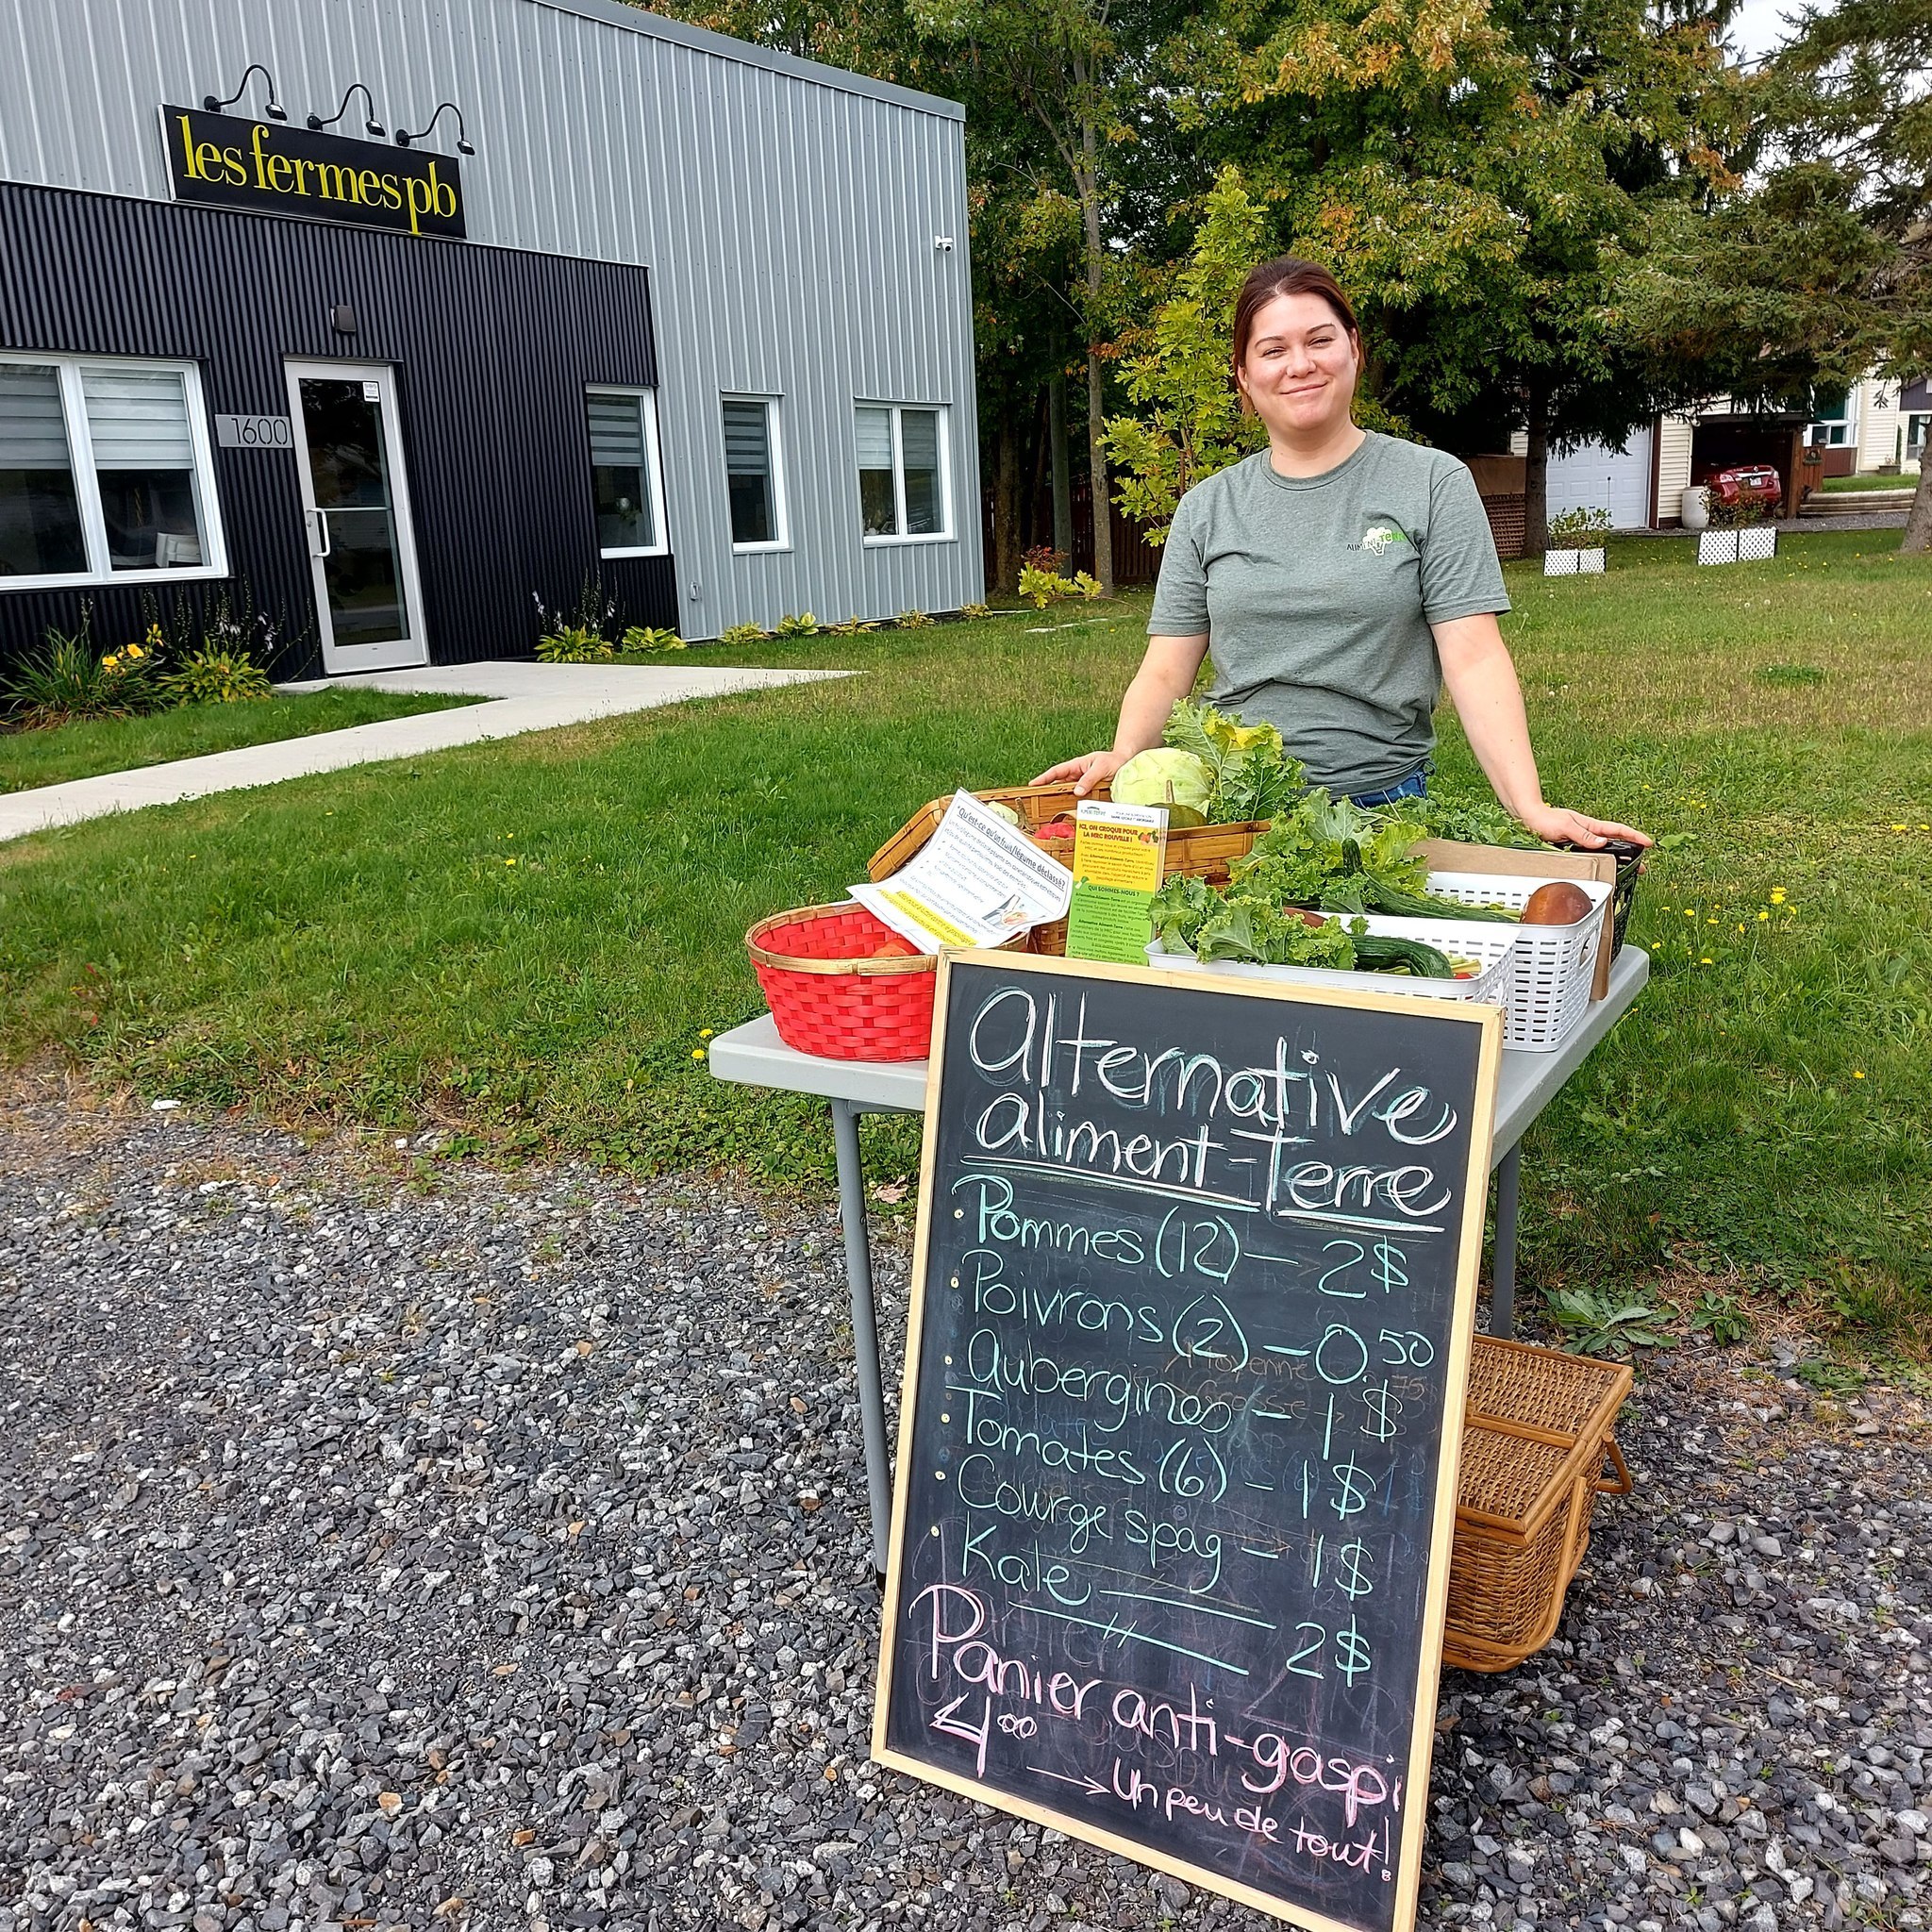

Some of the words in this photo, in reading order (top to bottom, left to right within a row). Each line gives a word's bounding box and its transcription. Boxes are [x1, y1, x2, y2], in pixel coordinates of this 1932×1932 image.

[231, 418, 288, 444] 1600
[1098, 825, 1122, 834] CROQUE
[1104, 833, 1129, 842] ROUVILLE
[1098, 887, 1136, 897] SOMMES-NOUS
[951, 1174, 1144, 1264] Pommes
[1156, 1206, 1240, 1284] (12)
[1319, 1235, 1408, 1298] 2$
[962, 1249, 1164, 1343] Poivrons
[1173, 1294, 1248, 1373] (2)
[945, 1385, 1145, 1485] Tomates
[1158, 1438, 1226, 1502] (6)
[958, 1454, 1112, 1554] Courge
[1124, 1509, 1221, 1593] spag
[962, 1510, 1091, 1605] Kale
[1286, 1613, 1371, 1688] 2$
[908, 1584, 1103, 1720] Panier
[1112, 1682, 1402, 1827] anti-gaspi
[1165, 1788, 1228, 1821] peu
[1234, 1807, 1283, 1844] de
[1289, 1816, 1391, 1881] tout!
